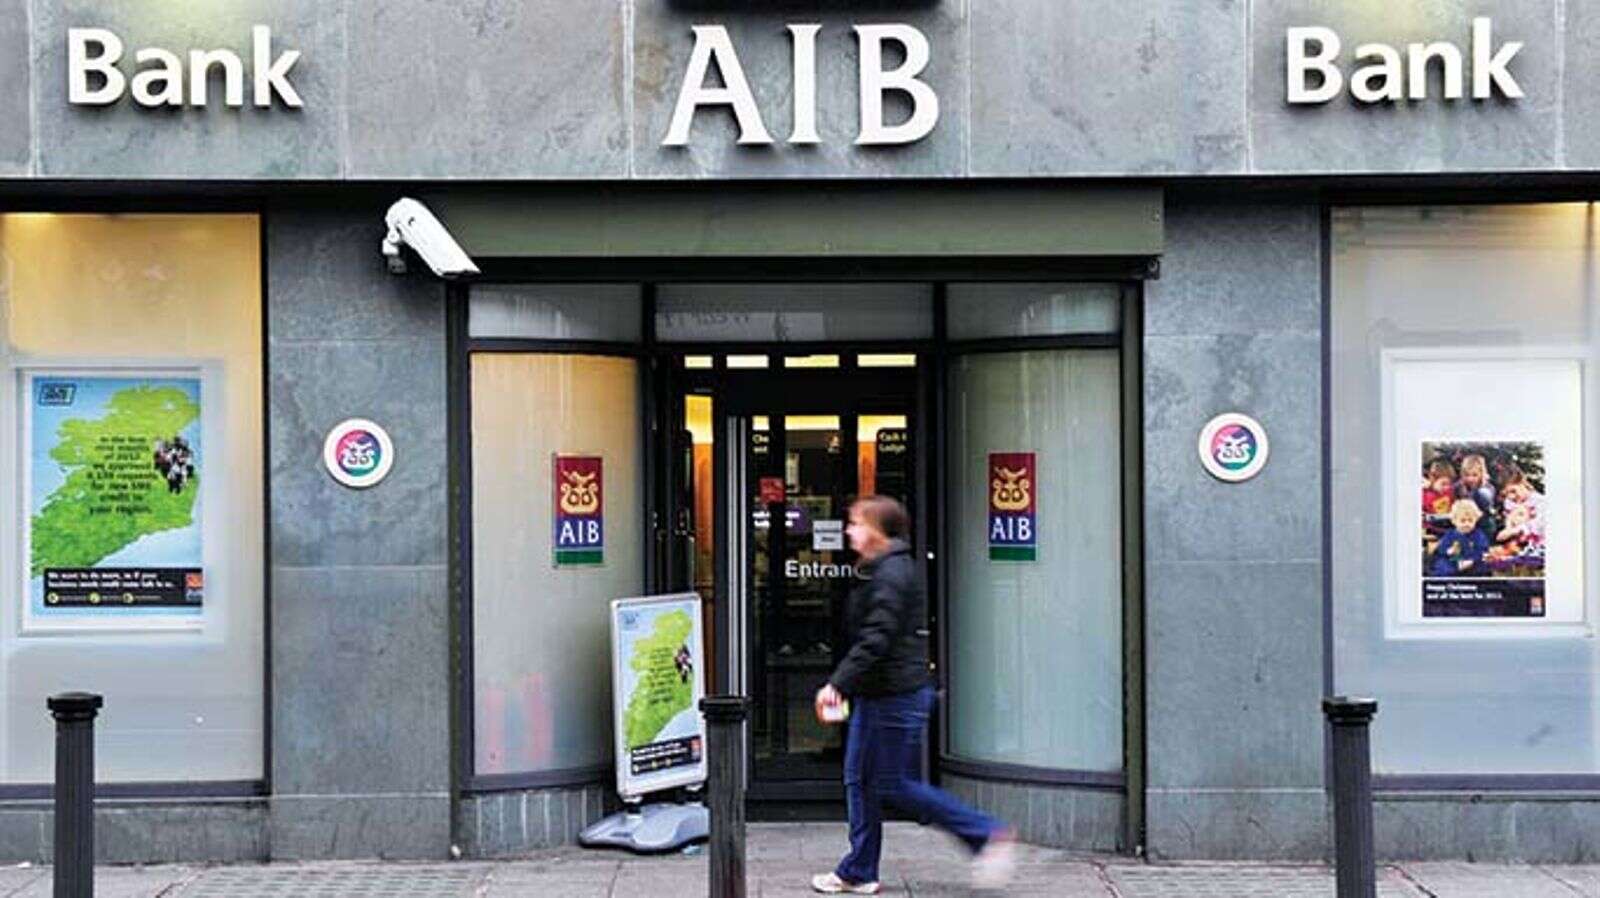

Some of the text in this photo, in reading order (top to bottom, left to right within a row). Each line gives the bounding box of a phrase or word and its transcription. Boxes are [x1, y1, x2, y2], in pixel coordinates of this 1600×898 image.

[66, 24, 303, 107] Bank
[662, 24, 939, 146] AIB
[1285, 17, 1524, 103] Bank
[560, 520, 600, 544] AIB
[991, 516, 1031, 541] AIB
